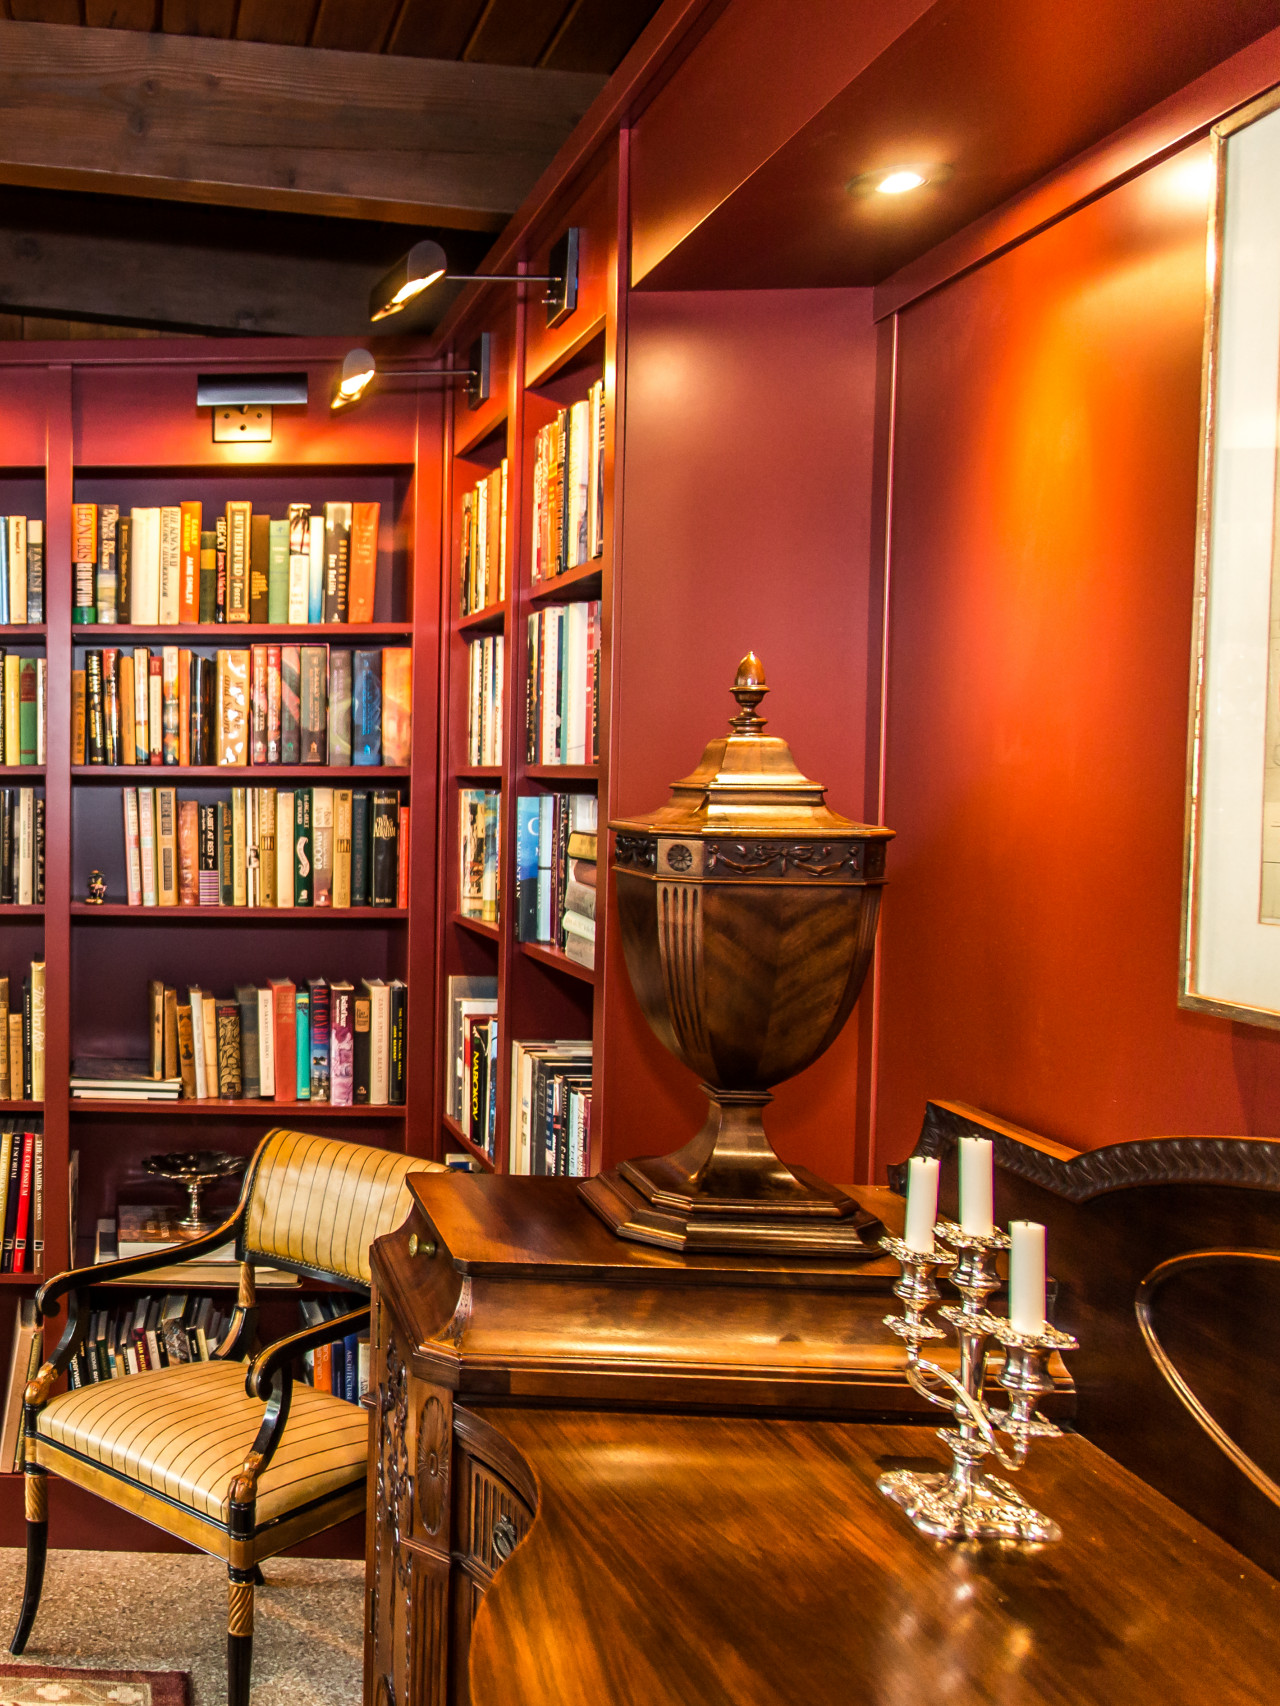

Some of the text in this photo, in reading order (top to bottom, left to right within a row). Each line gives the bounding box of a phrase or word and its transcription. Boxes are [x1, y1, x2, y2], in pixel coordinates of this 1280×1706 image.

[78, 507, 92, 559] LEON URIS
[32, 547, 42, 592] FAMINE
[186, 556, 194, 604] JANE SMILEY
[234, 515, 244, 607] RUTHERFURD Forest
[328, 554, 337, 595] Don DeLillo
[338, 540, 347, 610] UNDERWORLD
[77, 563, 92, 606] REDEMPTION
[207, 831, 214, 839] AT
[224, 830, 232, 885] The Instrument
[314, 989, 328, 1044] PAT CONROY
[11, 1136, 20, 1178] EL ESCORIAL
[22, 1155, 31, 1196] COLOSSEUM
